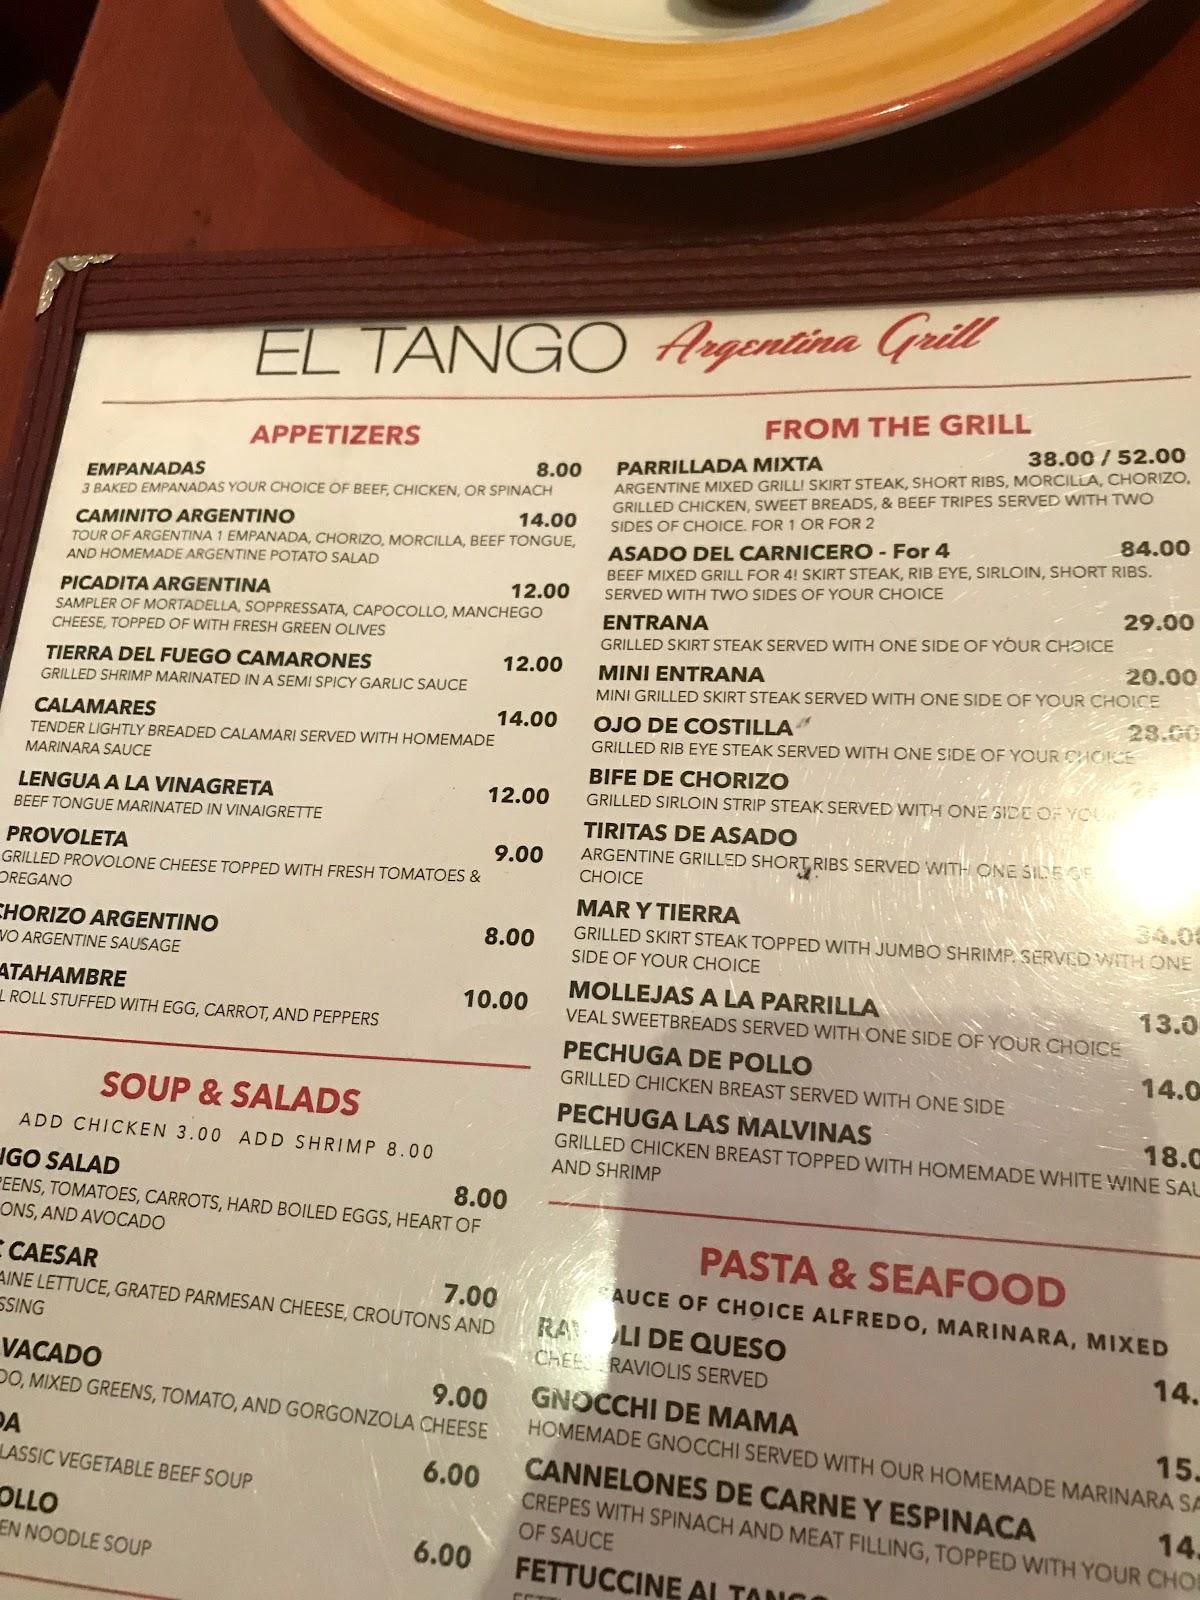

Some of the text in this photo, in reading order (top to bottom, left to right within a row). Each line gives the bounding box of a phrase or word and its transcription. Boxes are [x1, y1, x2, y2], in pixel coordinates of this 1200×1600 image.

[256, 312, 1000, 375] EL TANGO Argentina Grill
[250, 425, 420, 445] APPETIZERS
[766, 414, 1032, 440] FROM THE GRILL
[617, 456, 823, 476] PARRILLADA MIXTA
[1028, 450, 1094, 467] 38.00
[1118, 448, 1186, 465] 52.00
[87, 460, 206, 476] EMPANADAS
[537, 462, 582, 477] 8.00
[82, 481, 553, 497] 3 BAKED EMPANADAS YOUR CHOICE OF BEEF, CHICKEN, OR SPINACH
[614, 471, 1190, 494] ARGENTINE MIXED GRILL! SKIRT STEAK, SHORT RIBS, MORCILLA, CHORIZO,
[76, 508, 295, 524] CAMINITO ARGENTINO
[519, 513, 577, 528] 14.00
[66, 547, 379, 564] AND HOMEMADE ARGENTINE POTATO SALAD
[608, 546, 687, 562] ASADO
[693, 546, 734, 561] DEL
[739, 543, 873, 561] CARNICERO
[893, 543, 930, 559] For
[935, 543, 950, 558] 4
[1121, 540, 1190, 557] 84.00
[60, 575, 271, 593] PICADITA ARGENTINA
[512, 583, 570, 599] 12.00
[605, 587, 943, 601] SERVED WITH TWO SIDES OF YOUR CHOICE
[603, 615, 709, 630] ENTRANA
[1124, 614, 1194, 631] 29.00
[46, 645, 372, 669] TIERRA DEL FUEGO CAMARONES
[504, 656, 563, 672] 12.00
[41, 667, 468, 691] GRILLED SHRIMP MARINATED IN A SEMI SPICY GARLIC SAUCE
[599, 665, 765, 682] MINI ENTRANA
[1126, 668, 1197, 686] 20.00
[35, 697, 156, 716] CALAMARES
[498, 710, 557, 727] 14.00
[594, 716, 793, 736] OJO DE COSTILLA
[26, 740, 152, 756] MARINARA SAUCE
[18, 770, 274, 796] LENGUA A LA VINAGRETA
[589, 768, 789, 790] BIFE DE CHORIZO
[489, 787, 549, 804] 12.00
[14, 794, 323, 819] BEEF TONGUE MARINATED IN VINAIGRETTE
[6, 825, 128, 847] PROVOLETA
[584, 822, 797, 847] TIRITAS DE ASADO
[495, 845, 543, 863] 9.00
[577, 899, 740, 924] MAR Y TIERRA
[485, 927, 535, 947] 8.00
[464, 989, 528, 1010] 10.00
[569, 980, 880, 1018] MOLLEJAS A LA PARRILLA
[563, 1040, 812, 1076] PECHUGA DE POLLO
[100, 1071, 361, 1116] SOUP & SALADS
[561, 1070, 1004, 1115] GRILLED CHICKEN BREAST SERVED WITH ONE SIDE
[557, 1103, 871, 1146] PECHUGA LAS MALVINAS
[19, 1113, 433, 1159] ADD CHICKEN 3.00 ADD SHRIMP 8.00
[454, 1186, 507, 1209] 8.00
[701, 1247, 1066, 1308] PASTA & SEAFOOD
[444, 1283, 497, 1308] 7.00
[433, 1383, 487, 1410] 9.00
[532, 1386, 799, 1436] GNOCCHI DE MAMA
[423, 1461, 479, 1488] 6.00
[525, 1457, 1036, 1542] CANNELONES DE CARNE Y ESPINACA
[414, 1540, 471, 1569] 6.00
